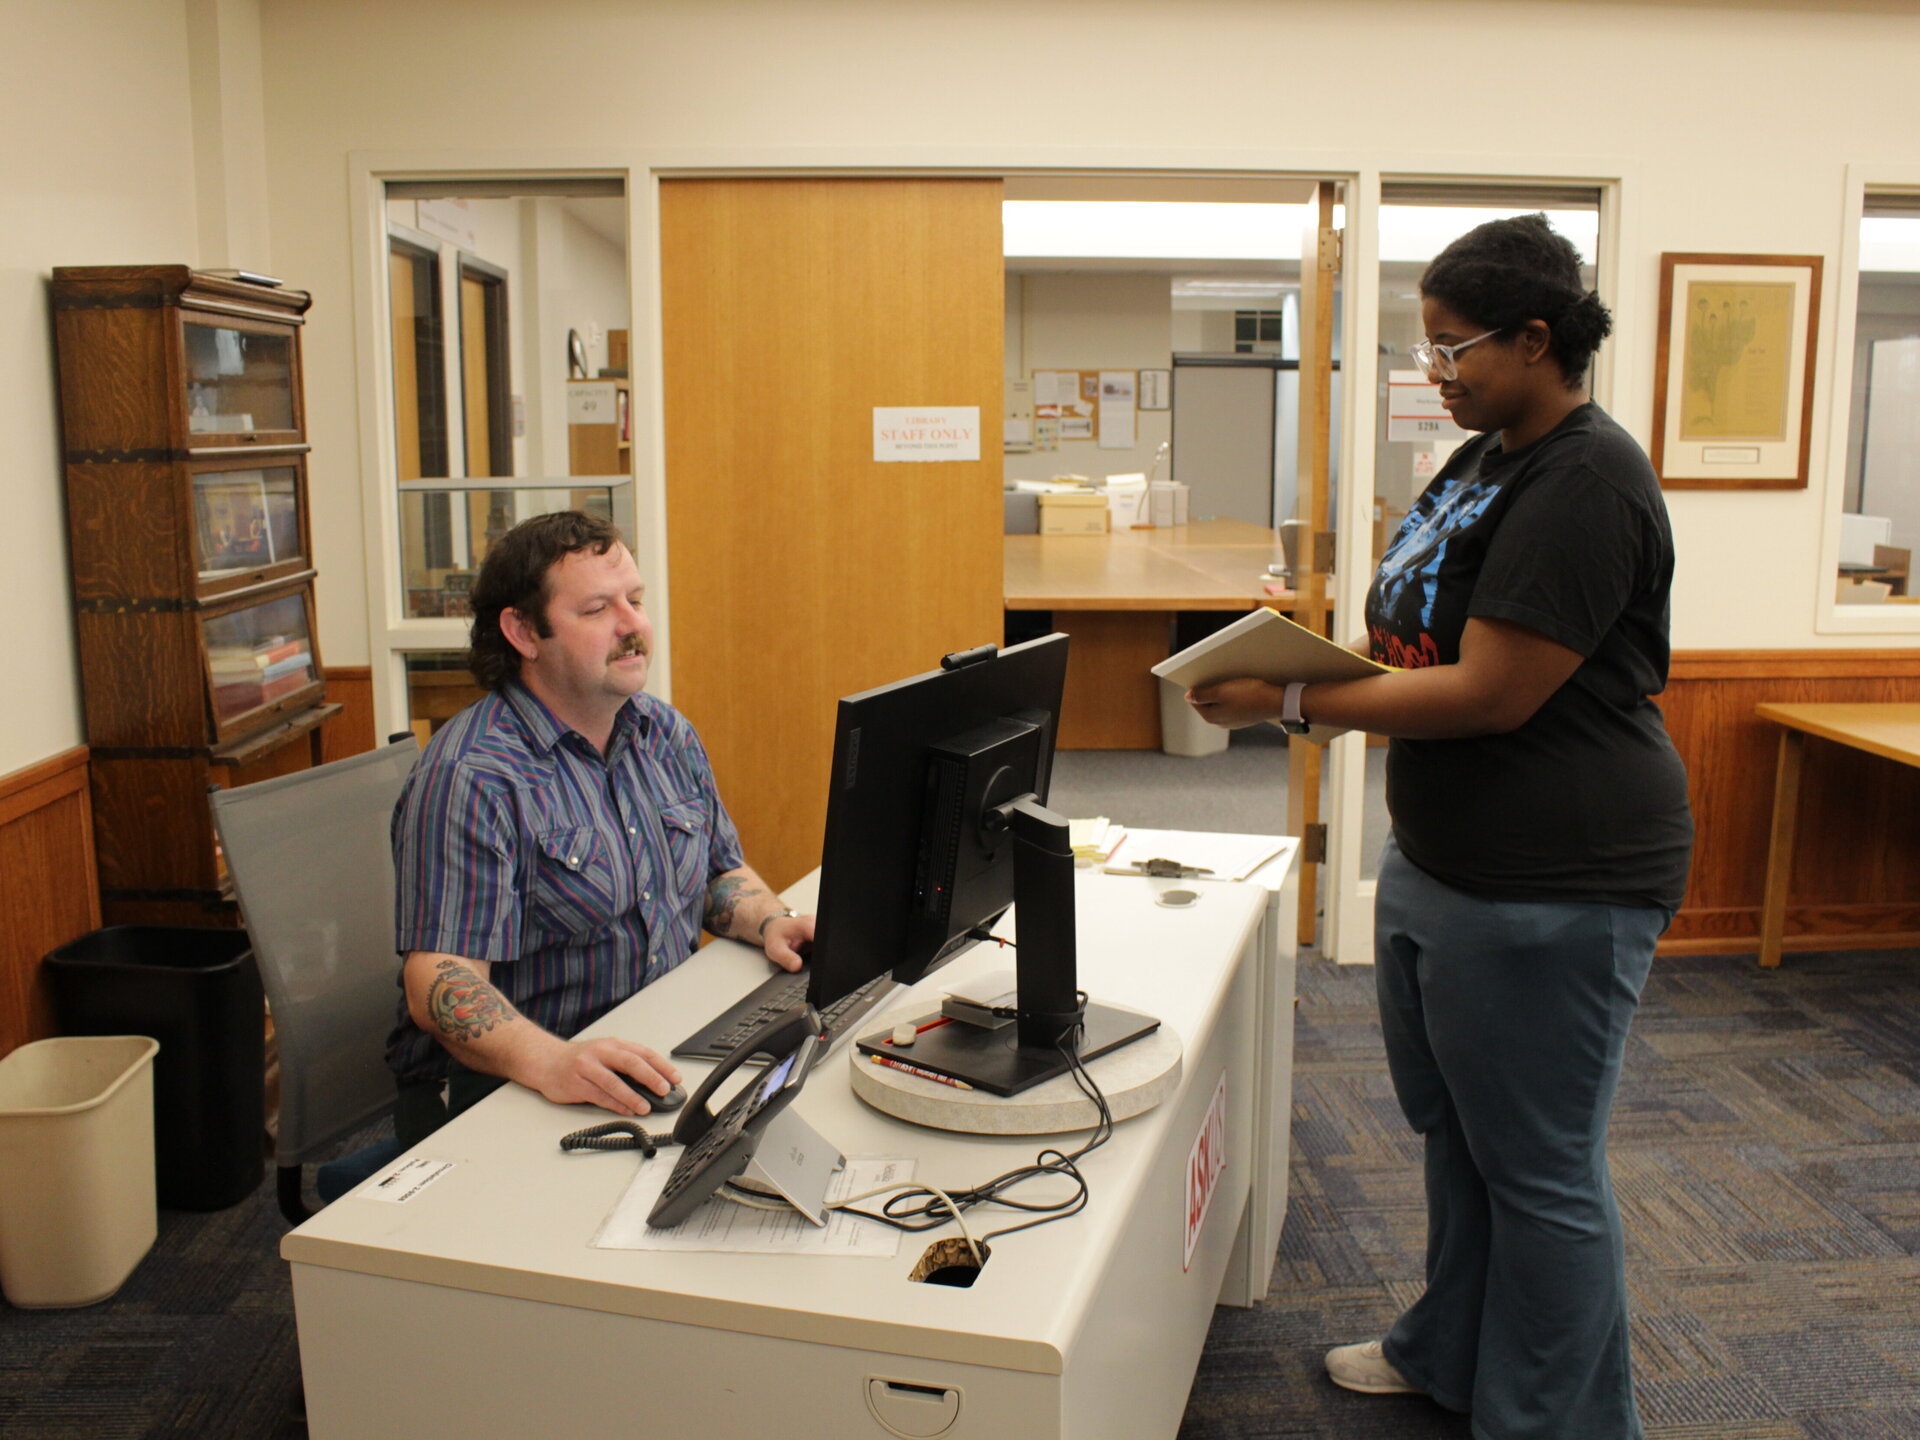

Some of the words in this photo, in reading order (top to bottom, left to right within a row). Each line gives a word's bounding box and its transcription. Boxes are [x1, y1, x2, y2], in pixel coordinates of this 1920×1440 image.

[905, 416, 947, 425] LIBRARY
[880, 428, 927, 440] STAFF
[930, 428, 973, 440] ONLY
[1188, 1115, 1212, 1248] ASK
